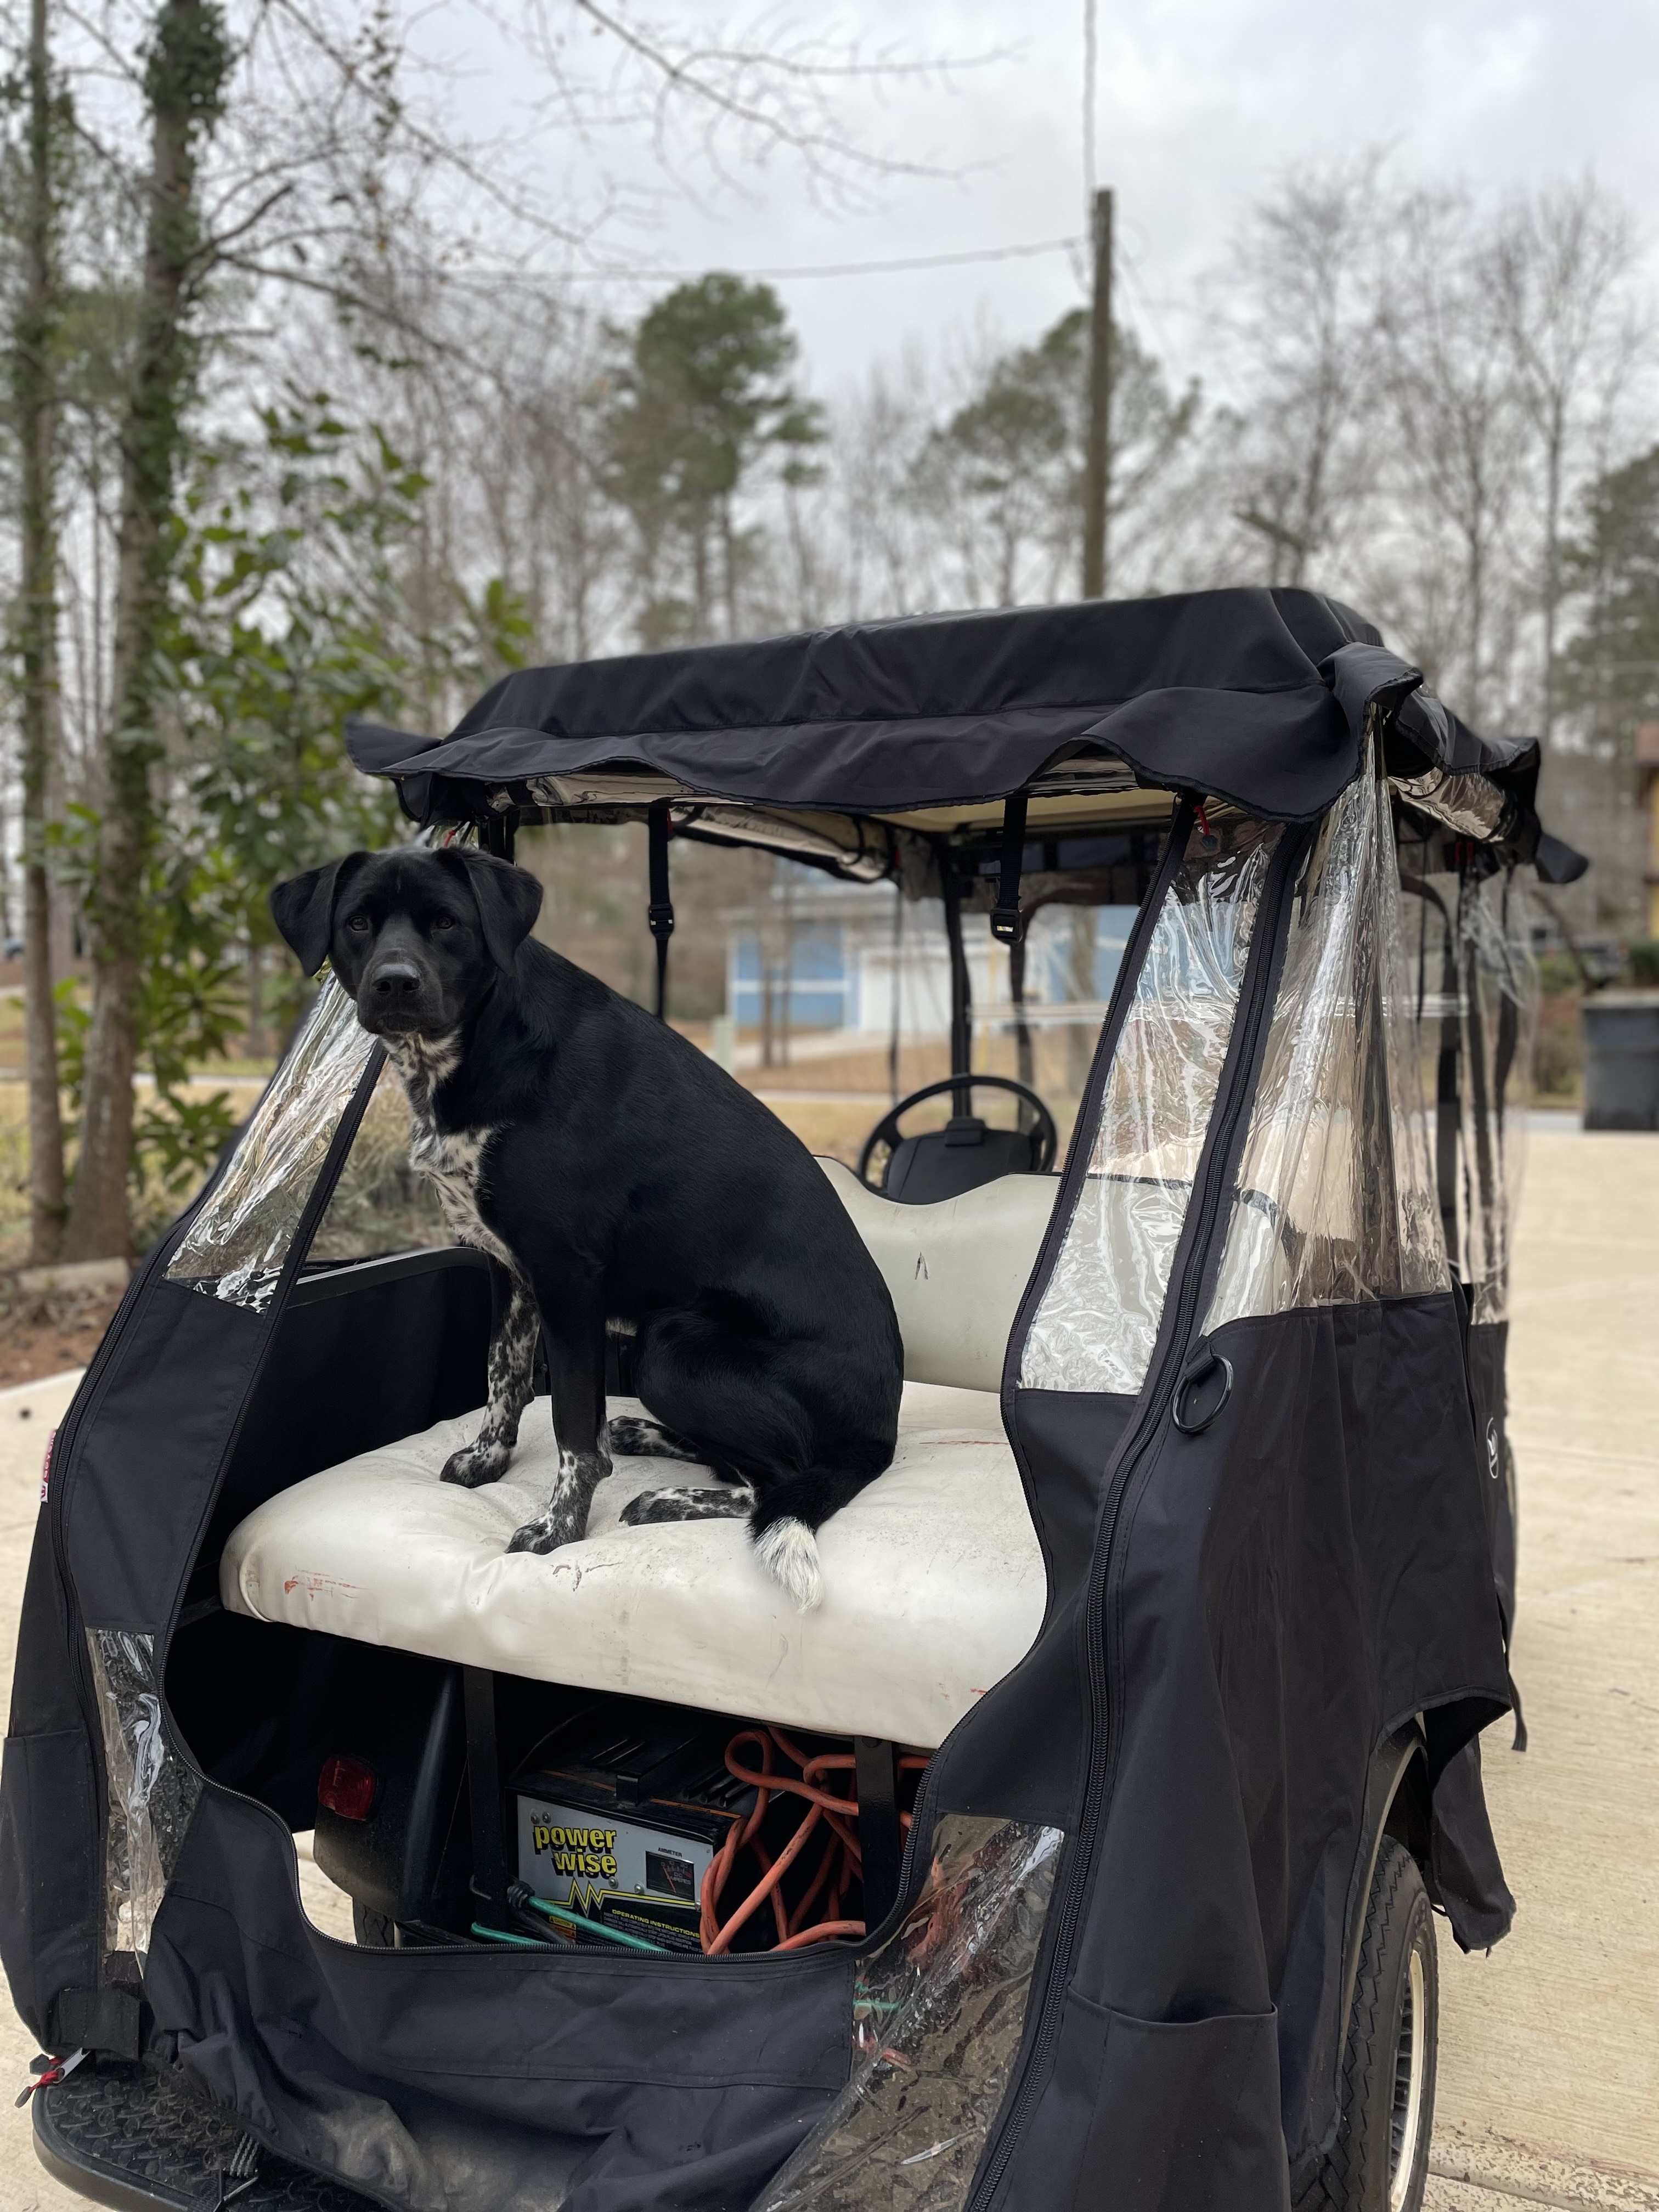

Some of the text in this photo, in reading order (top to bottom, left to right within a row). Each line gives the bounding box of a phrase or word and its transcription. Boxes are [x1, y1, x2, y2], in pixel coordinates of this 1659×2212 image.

[533, 1826, 617, 1851] power
[552, 1848, 617, 1875] wise
[658, 1847, 682, 1857] AMMETER
[612, 1909, 701, 1938] OPERATING INSTRUCTIONS
